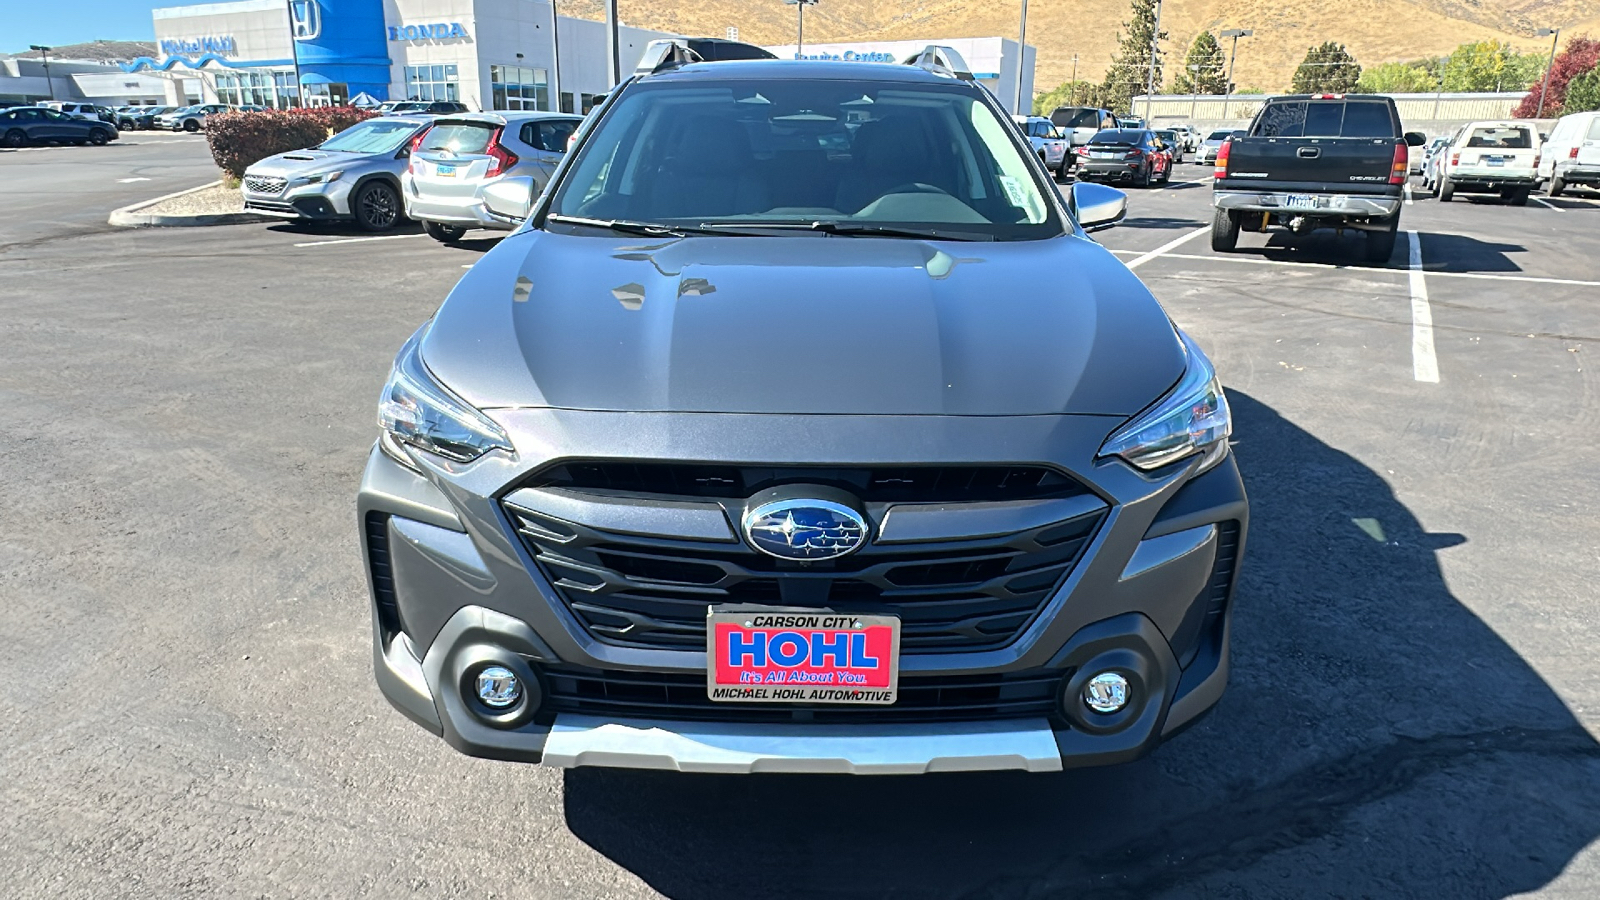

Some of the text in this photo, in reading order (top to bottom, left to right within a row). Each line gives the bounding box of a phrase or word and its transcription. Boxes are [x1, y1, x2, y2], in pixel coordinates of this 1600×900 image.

[388, 22, 466, 40] HONDA
[843, 50, 889, 62] Center
[753, 616, 858, 629] CARSON CITY
[729, 632, 878, 669] HOHL
[740, 671, 867, 683] It's All About You.
[713, 688, 892, 701] MICHAEL HOHL AUTOMOTIVE
